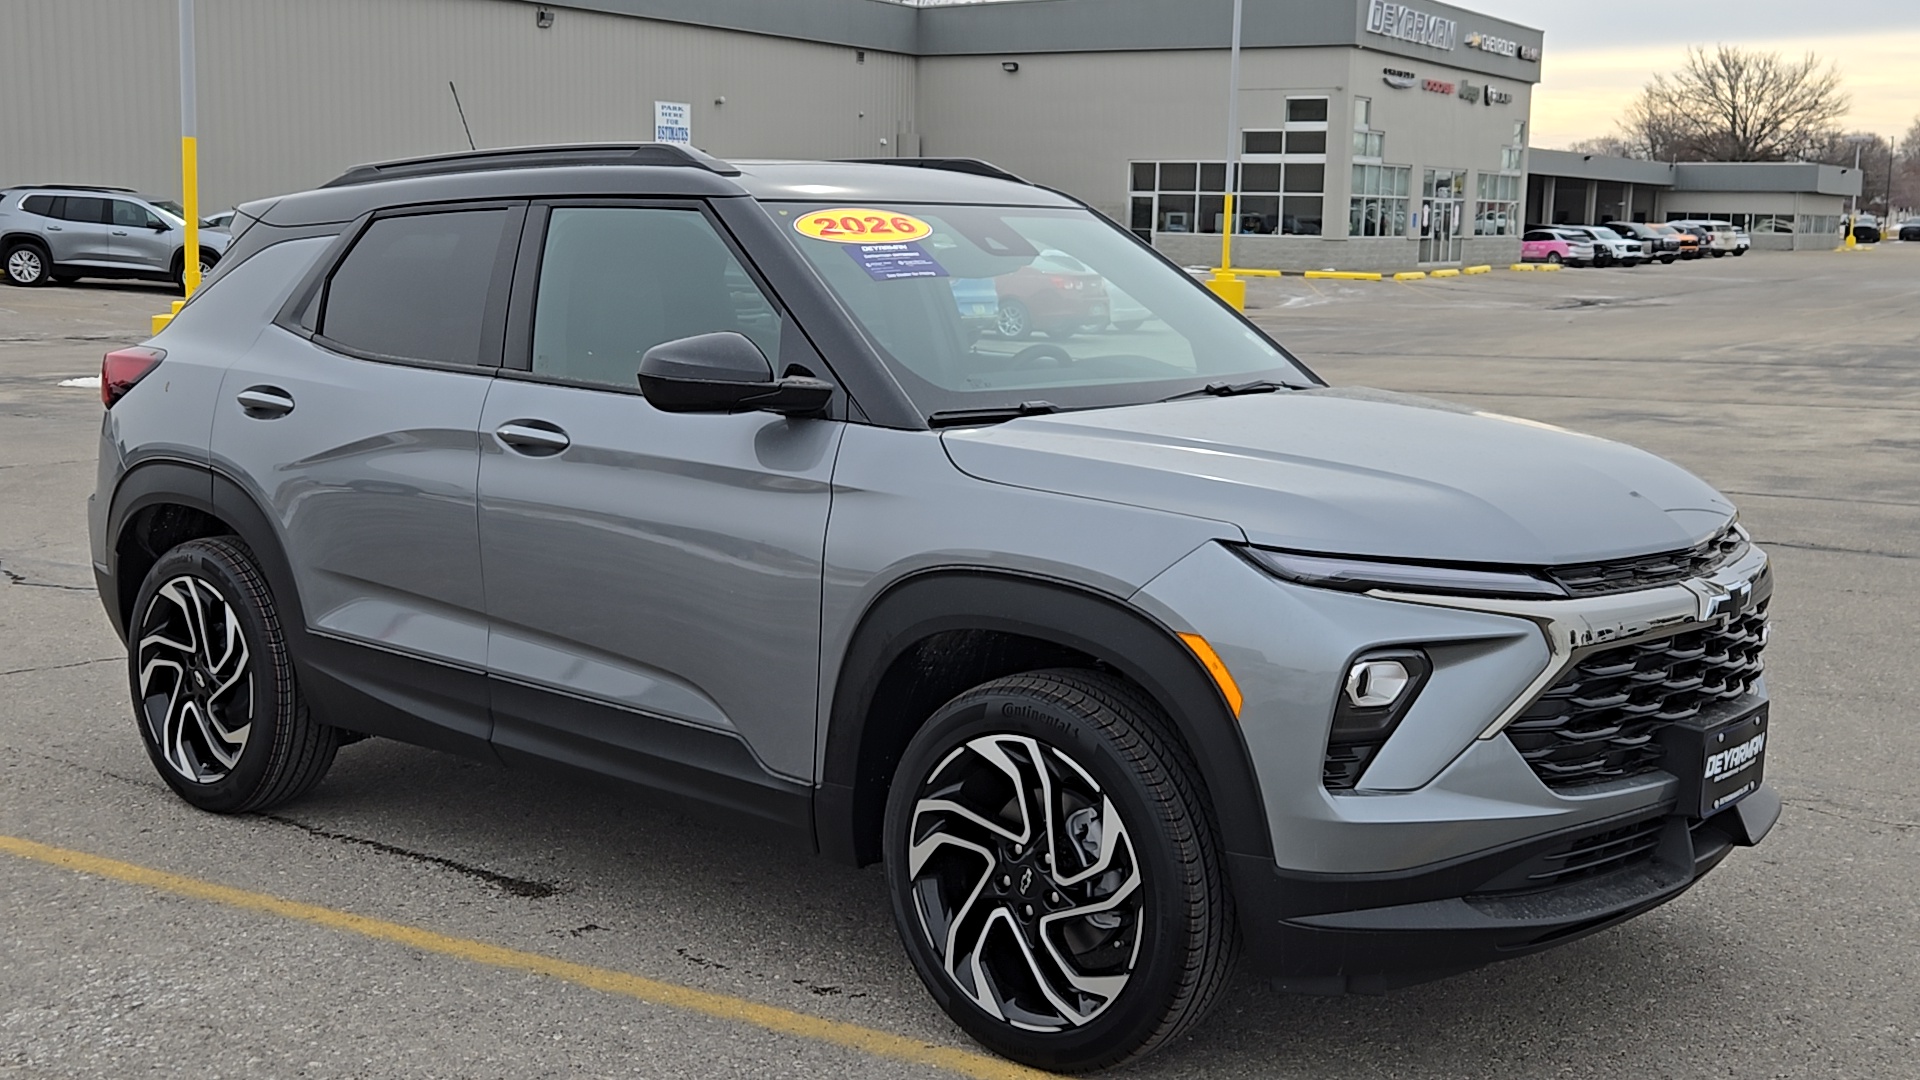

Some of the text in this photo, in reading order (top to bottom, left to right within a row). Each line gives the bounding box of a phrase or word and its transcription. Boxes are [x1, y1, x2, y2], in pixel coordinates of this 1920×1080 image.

[1366, 0, 1457, 51] DEYARMAN
[1481, 34, 1516, 57] CHEVROLET
[657, 125, 689, 142] ESTIMATES
[813, 216, 917, 236] 2026
[1002, 702, 1071, 734] Continental
[1704, 731, 1766, 779] DEYARMAN
